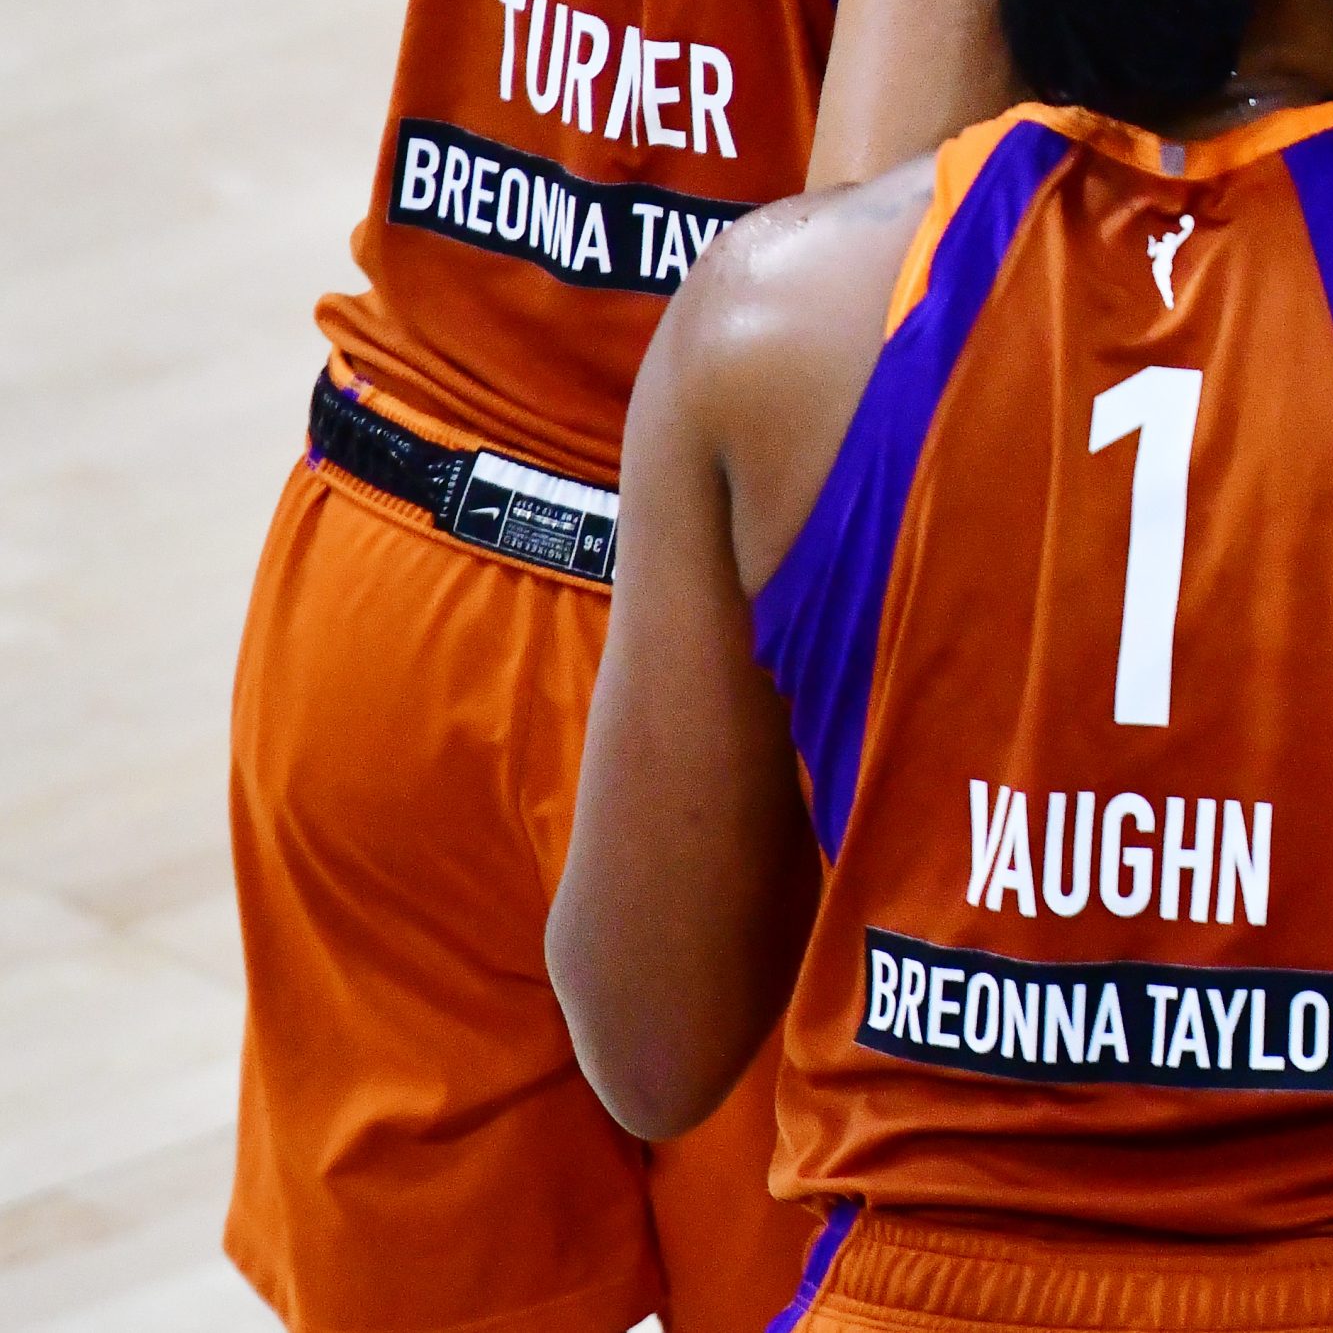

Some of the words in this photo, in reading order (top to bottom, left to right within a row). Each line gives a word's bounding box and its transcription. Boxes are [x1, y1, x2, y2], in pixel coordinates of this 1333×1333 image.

[399, 137, 612, 273] BREONNA
[632, 202, 735, 282] TAY
[1088, 365, 1202, 728] 1
[967, 779, 1273, 927] VAUGHN
[869, 949, 1130, 1064] BREONNA
